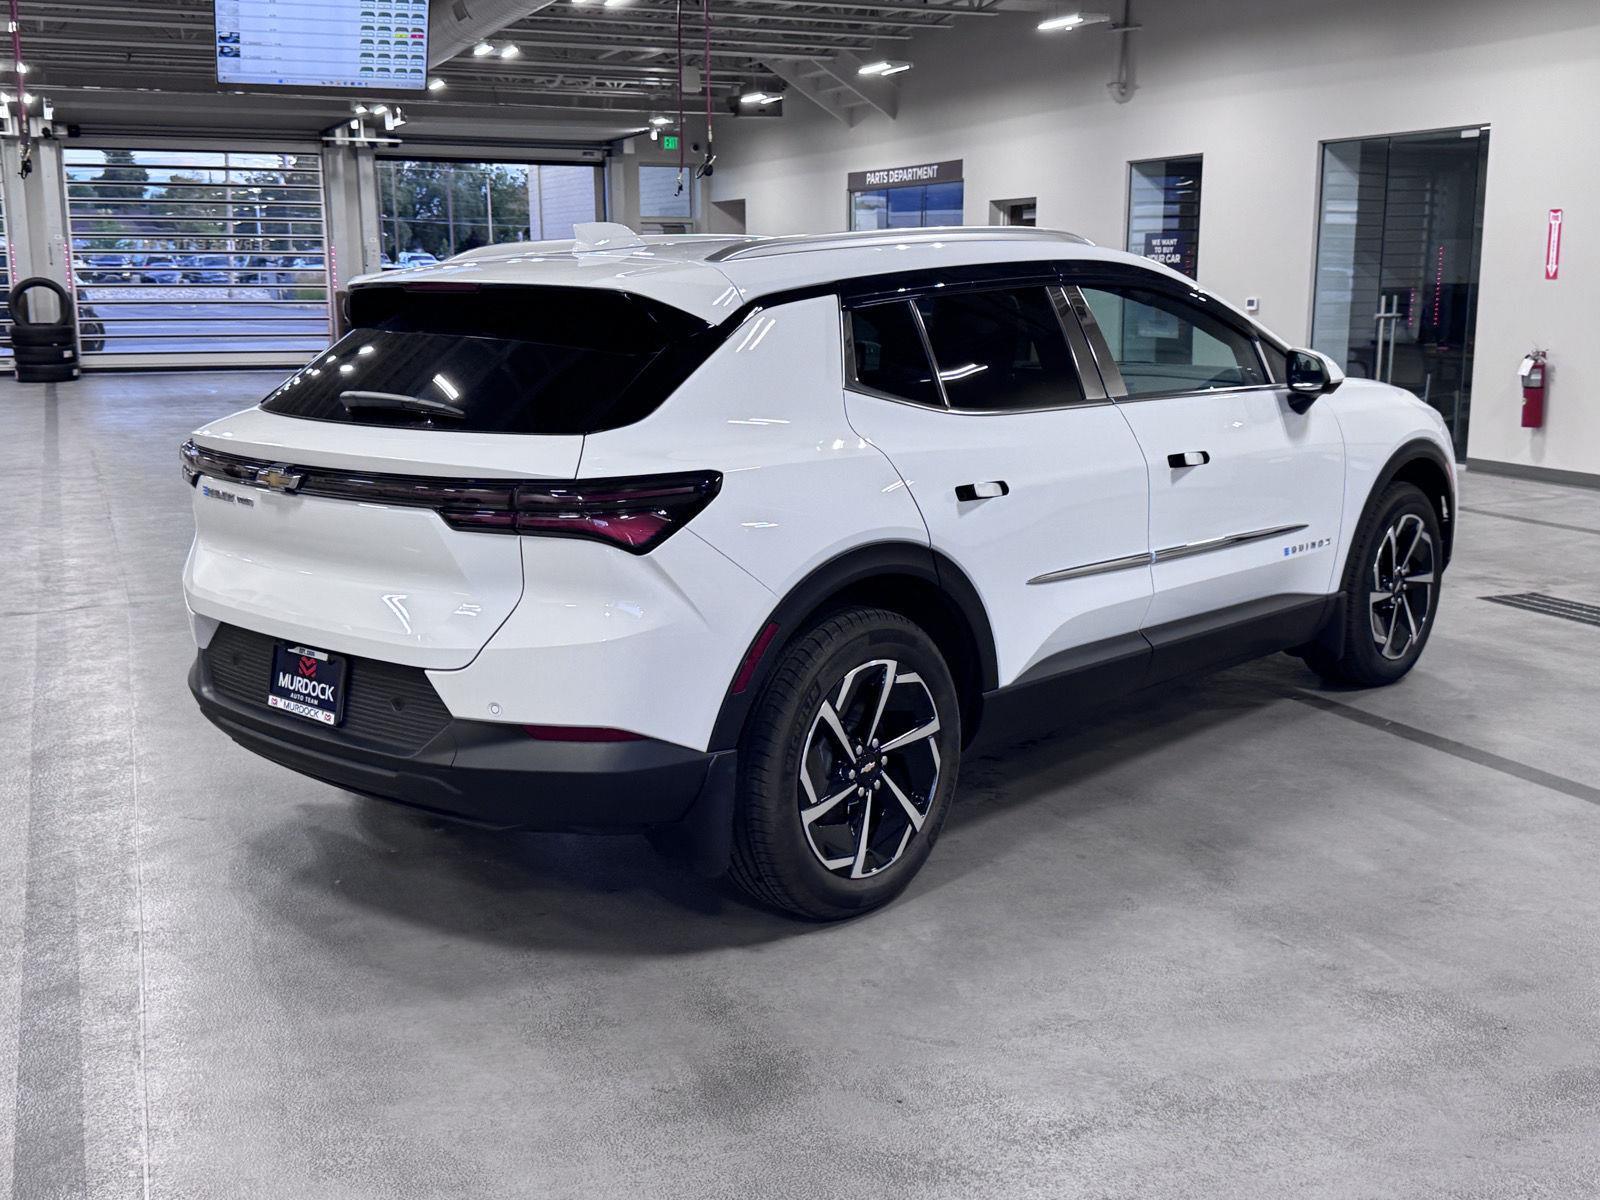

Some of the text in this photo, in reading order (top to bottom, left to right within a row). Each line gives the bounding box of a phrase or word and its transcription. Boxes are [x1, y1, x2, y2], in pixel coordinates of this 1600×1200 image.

[664, 136, 678, 149] EXIT
[866, 165, 938, 185] PARTS DEPARTMENT
[1162, 238, 1179, 246] WANT
[1165, 253, 1181, 263] CAR
[278, 671, 335, 702] MURDOCK
[290, 692, 319, 706] AUTO TEAM
[283, 701, 319, 718] MURDOCK
